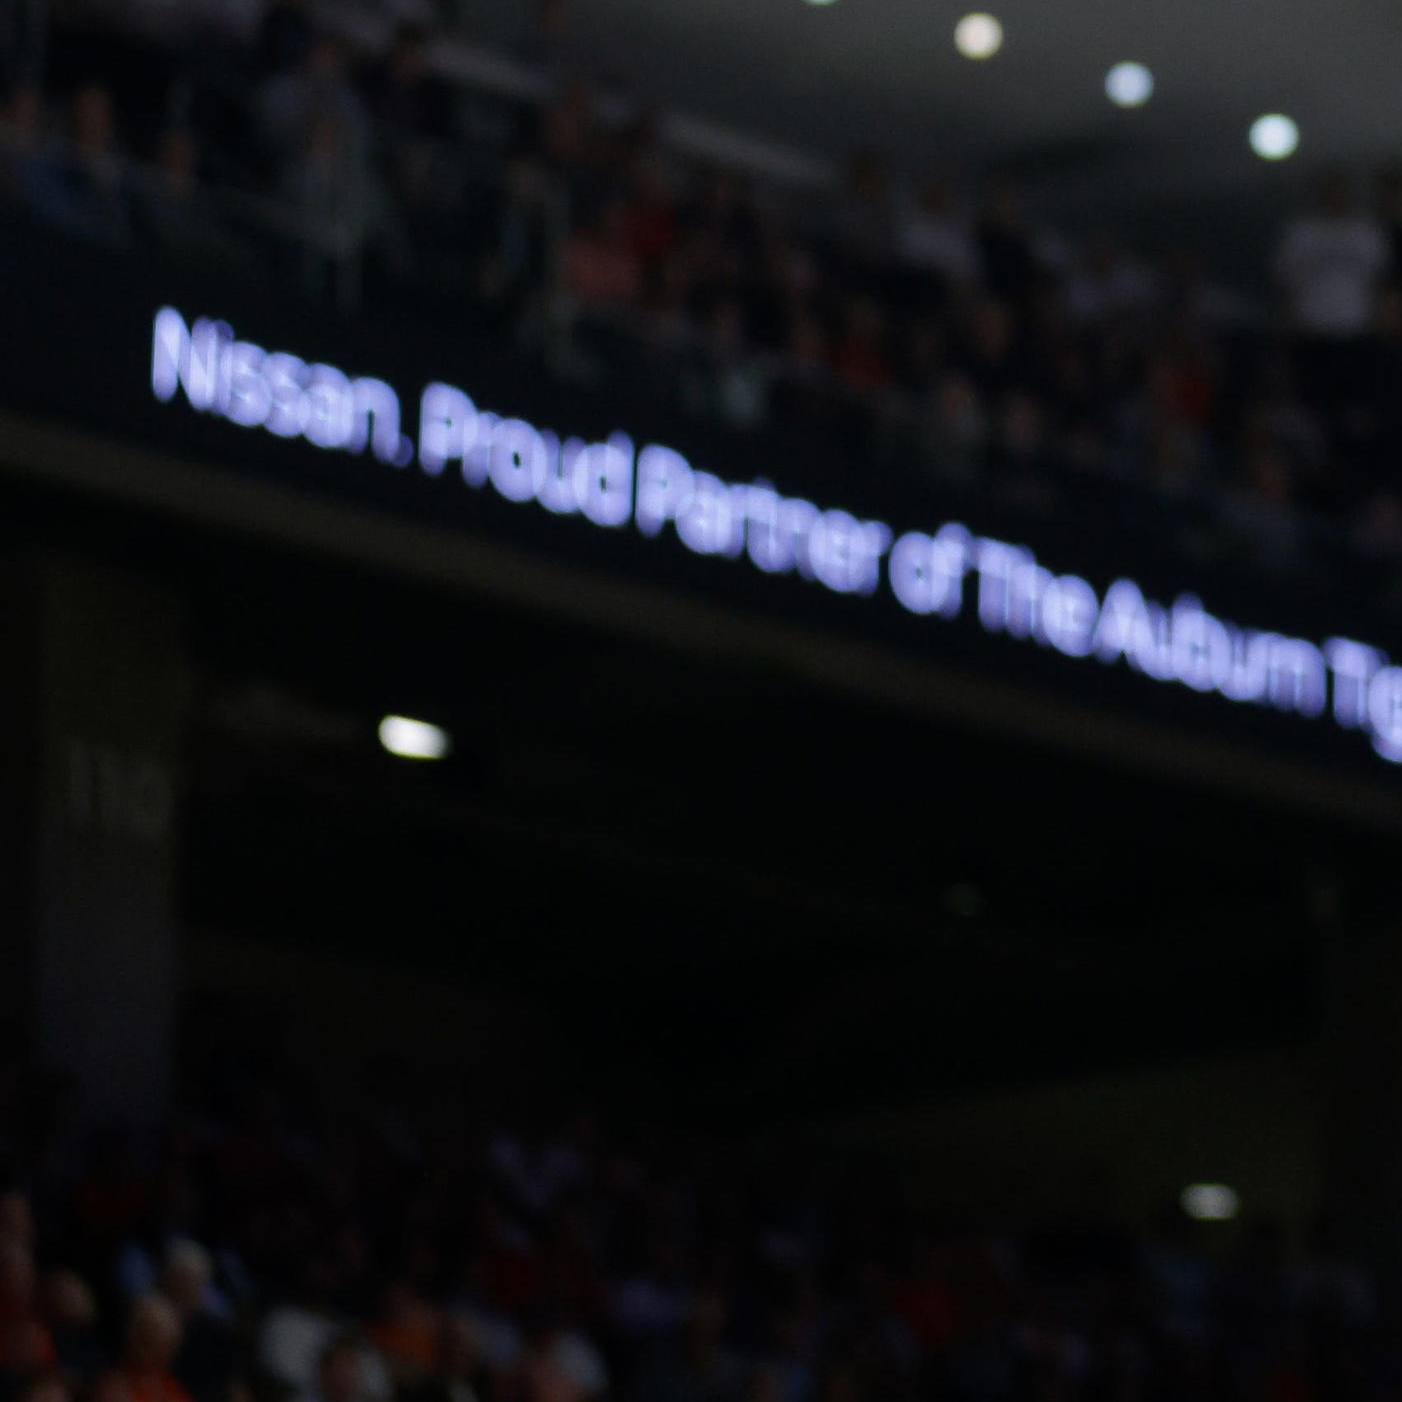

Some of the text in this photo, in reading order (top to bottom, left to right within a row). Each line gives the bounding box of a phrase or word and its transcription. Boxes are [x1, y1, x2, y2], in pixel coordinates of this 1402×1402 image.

[420, 382, 634, 527] Proud
[636, 444, 892, 594] Partner
[889, 521, 974, 619] of
[972, 536, 1099, 658] The
[1096, 578, 1327, 718] Auburn
